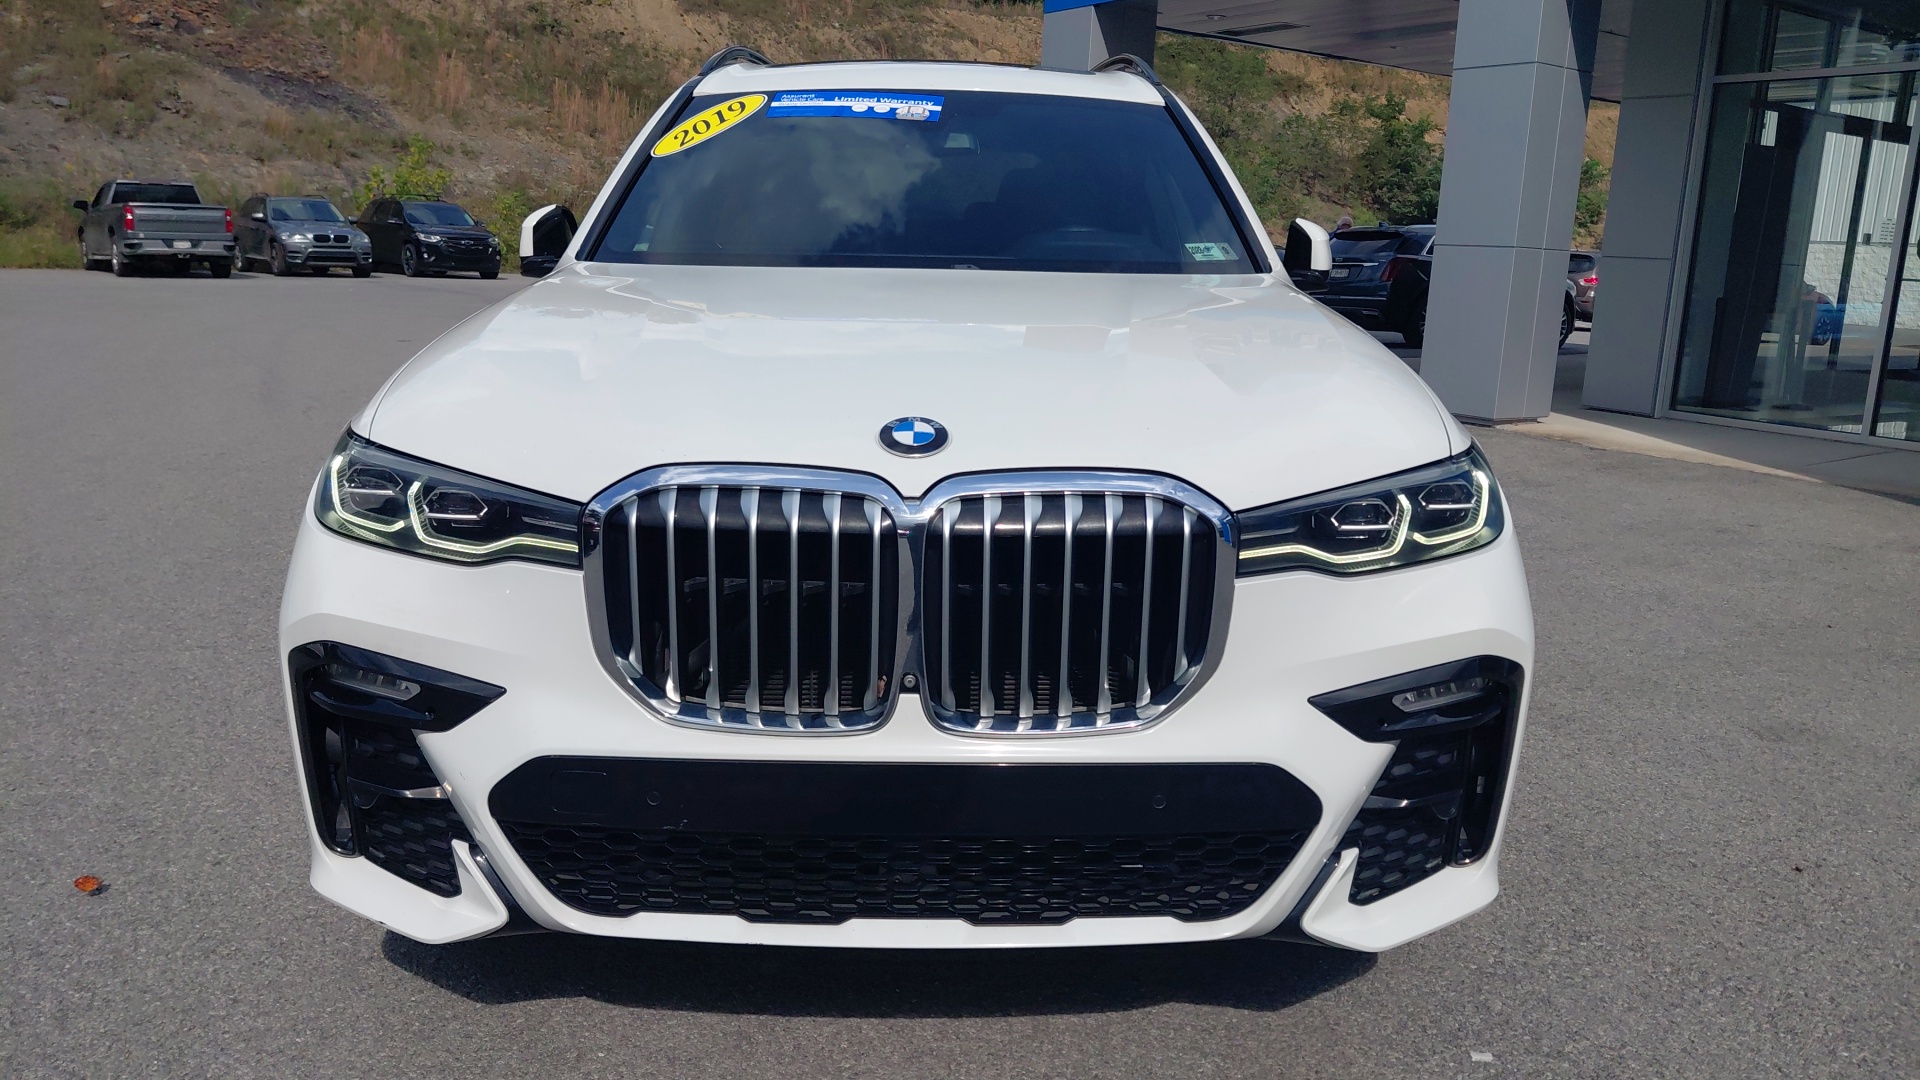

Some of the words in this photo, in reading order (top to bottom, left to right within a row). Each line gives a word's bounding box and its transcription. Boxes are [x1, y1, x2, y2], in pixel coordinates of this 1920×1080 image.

[879, 98, 935, 106] Warranty
[673, 100, 748, 148] 2019
[887, 417, 944, 429] BMW
